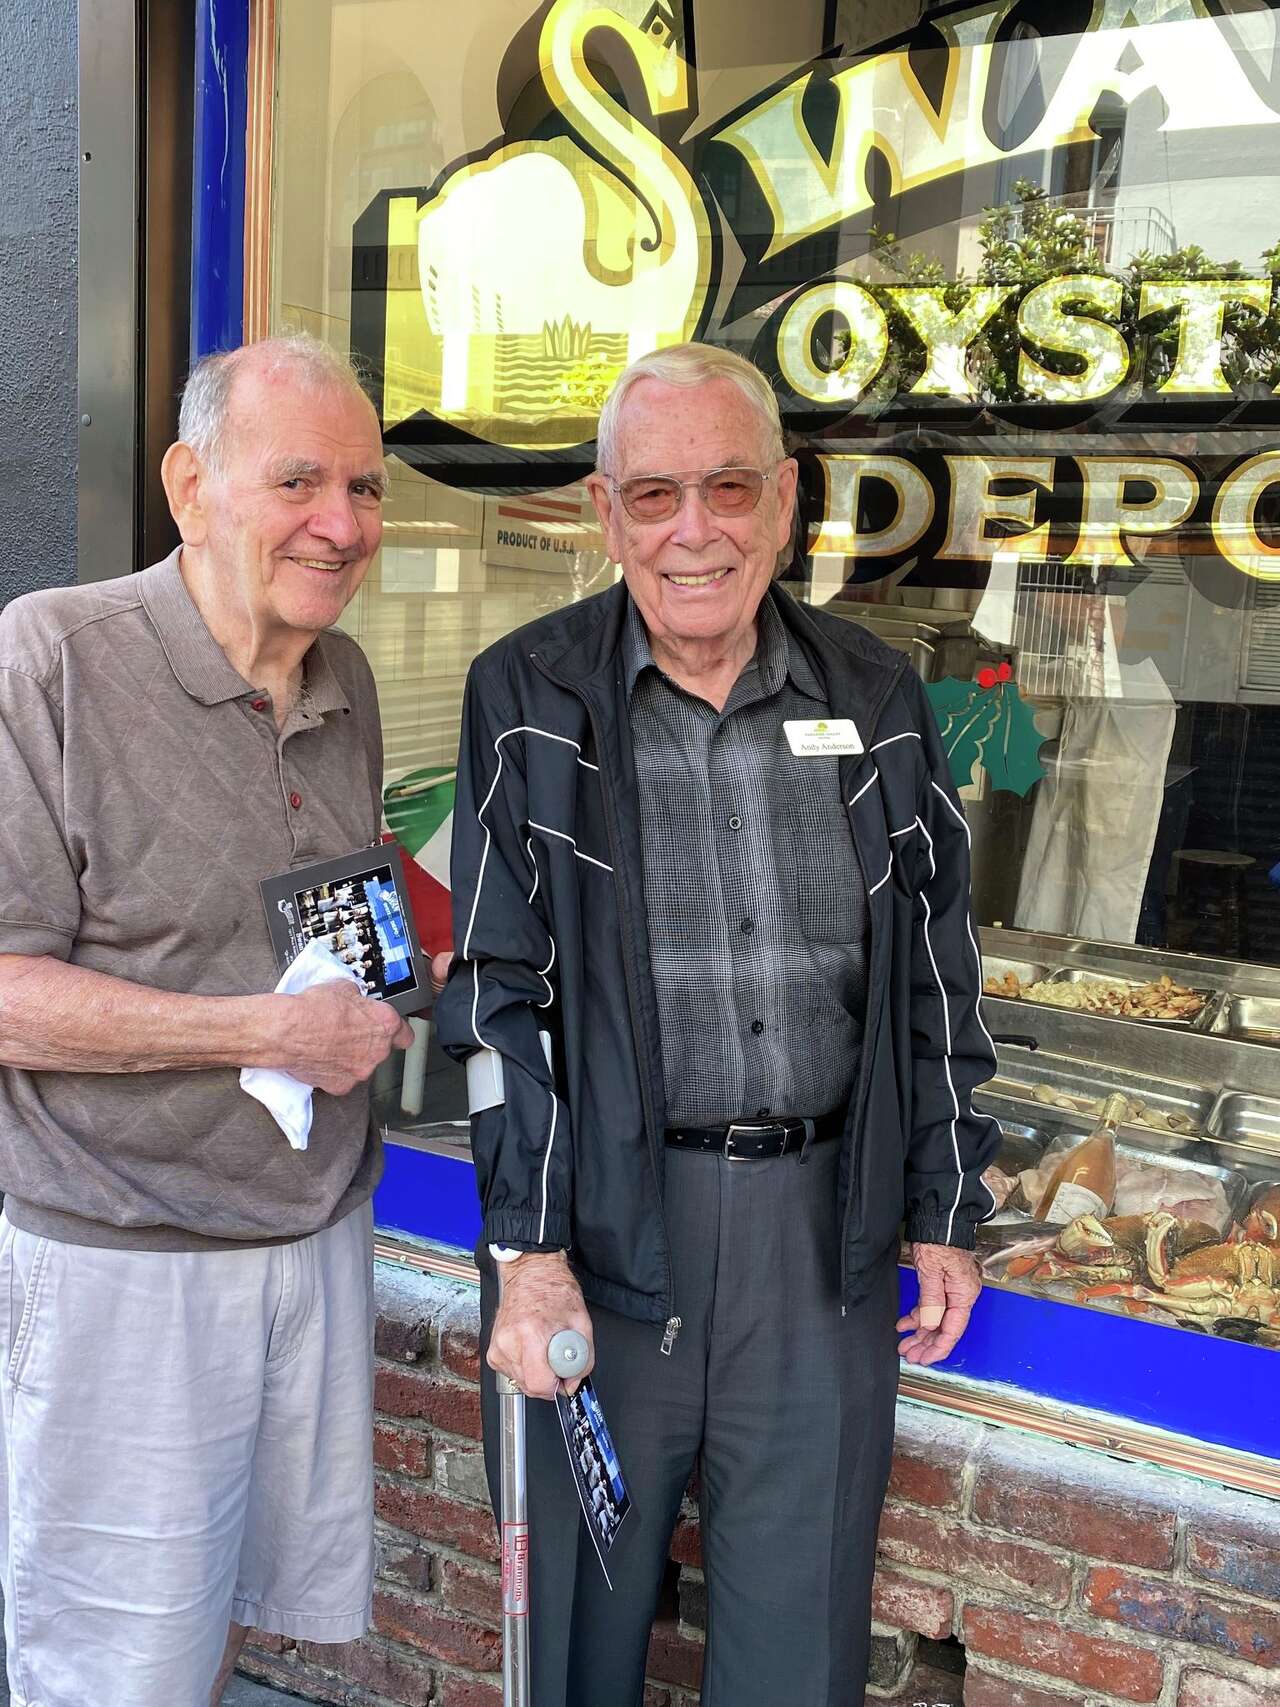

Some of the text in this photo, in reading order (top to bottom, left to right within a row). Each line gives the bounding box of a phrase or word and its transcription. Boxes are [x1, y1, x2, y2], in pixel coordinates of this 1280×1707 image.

[777, 272, 1280, 403] OYST
[497, 530, 538, 549] PRODUCT
[540, 536, 551, 552] OF
[801, 743, 820, 752] Andy
